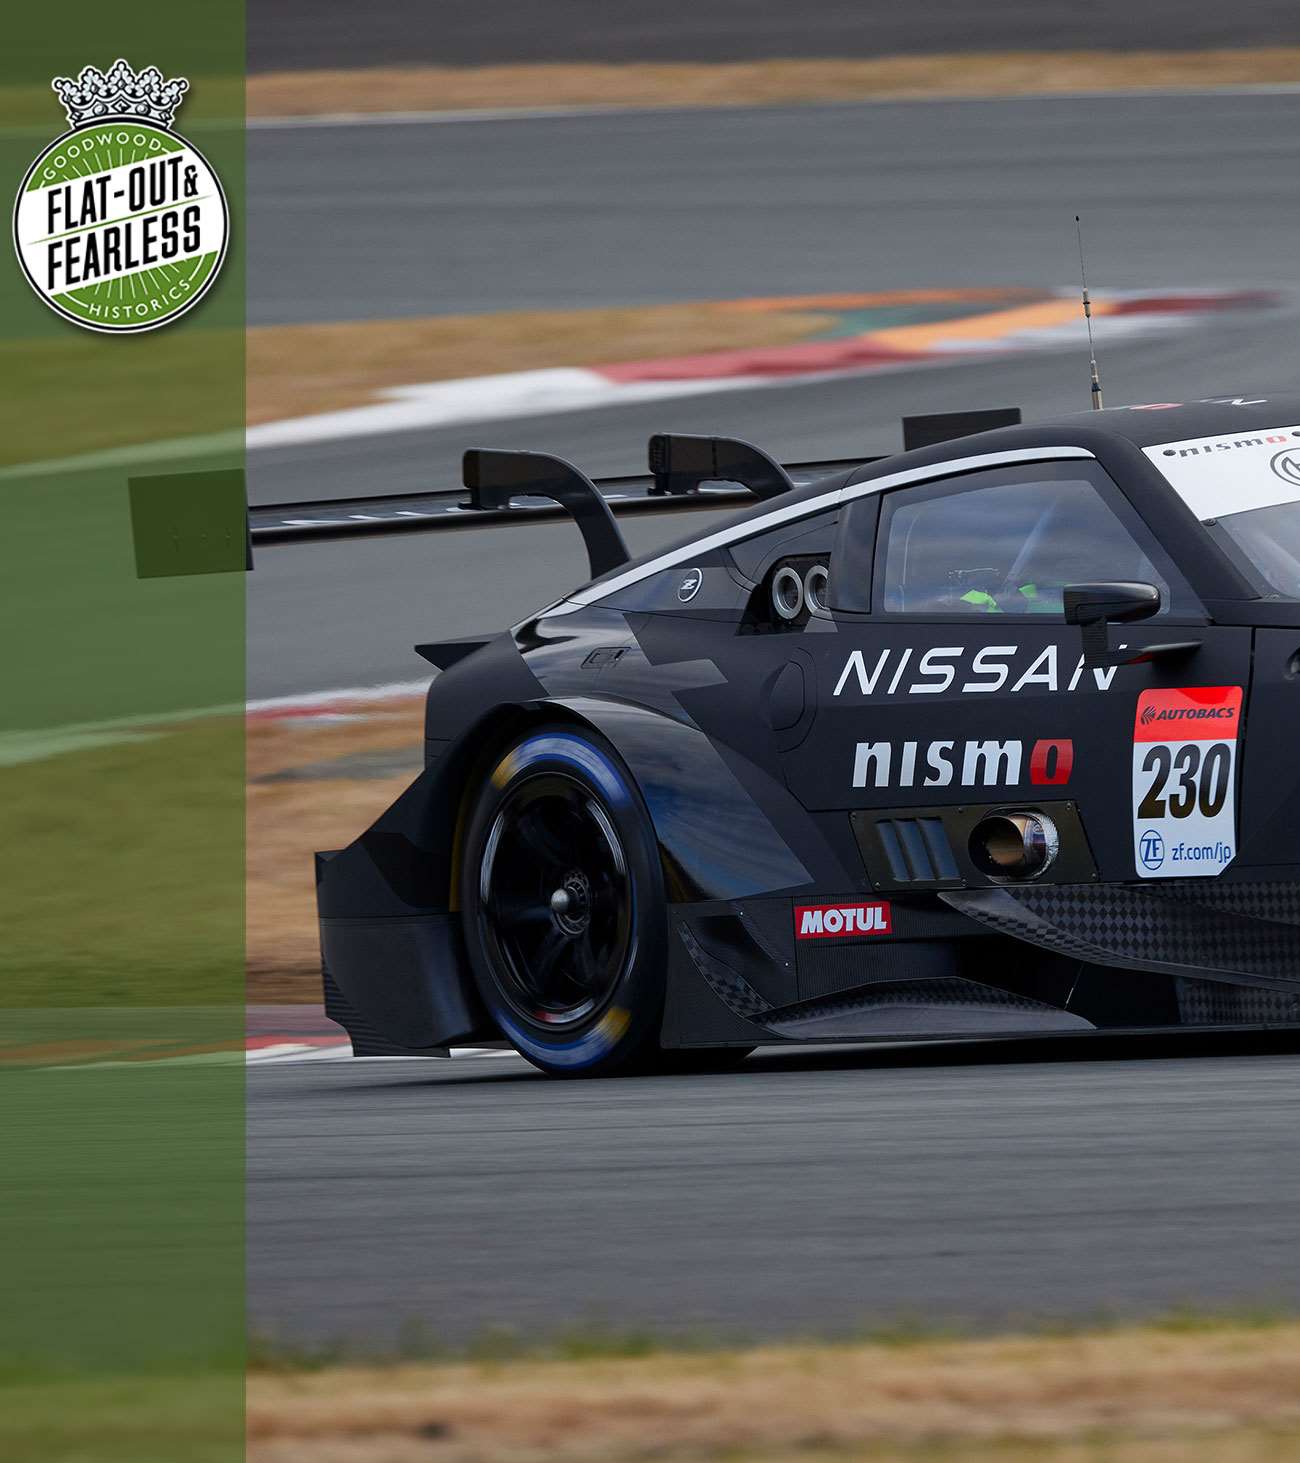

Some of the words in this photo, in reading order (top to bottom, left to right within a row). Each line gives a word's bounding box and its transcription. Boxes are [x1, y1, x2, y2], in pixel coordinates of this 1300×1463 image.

[1179, 434, 1287, 458] nismo
[1157, 707, 1235, 721] AUTOBACS
[852, 738, 1073, 788] nismo
[1137, 742, 1232, 819] 230
[1172, 842, 1232, 863] zf.com/jp
[800, 906, 888, 935] MOTUL
